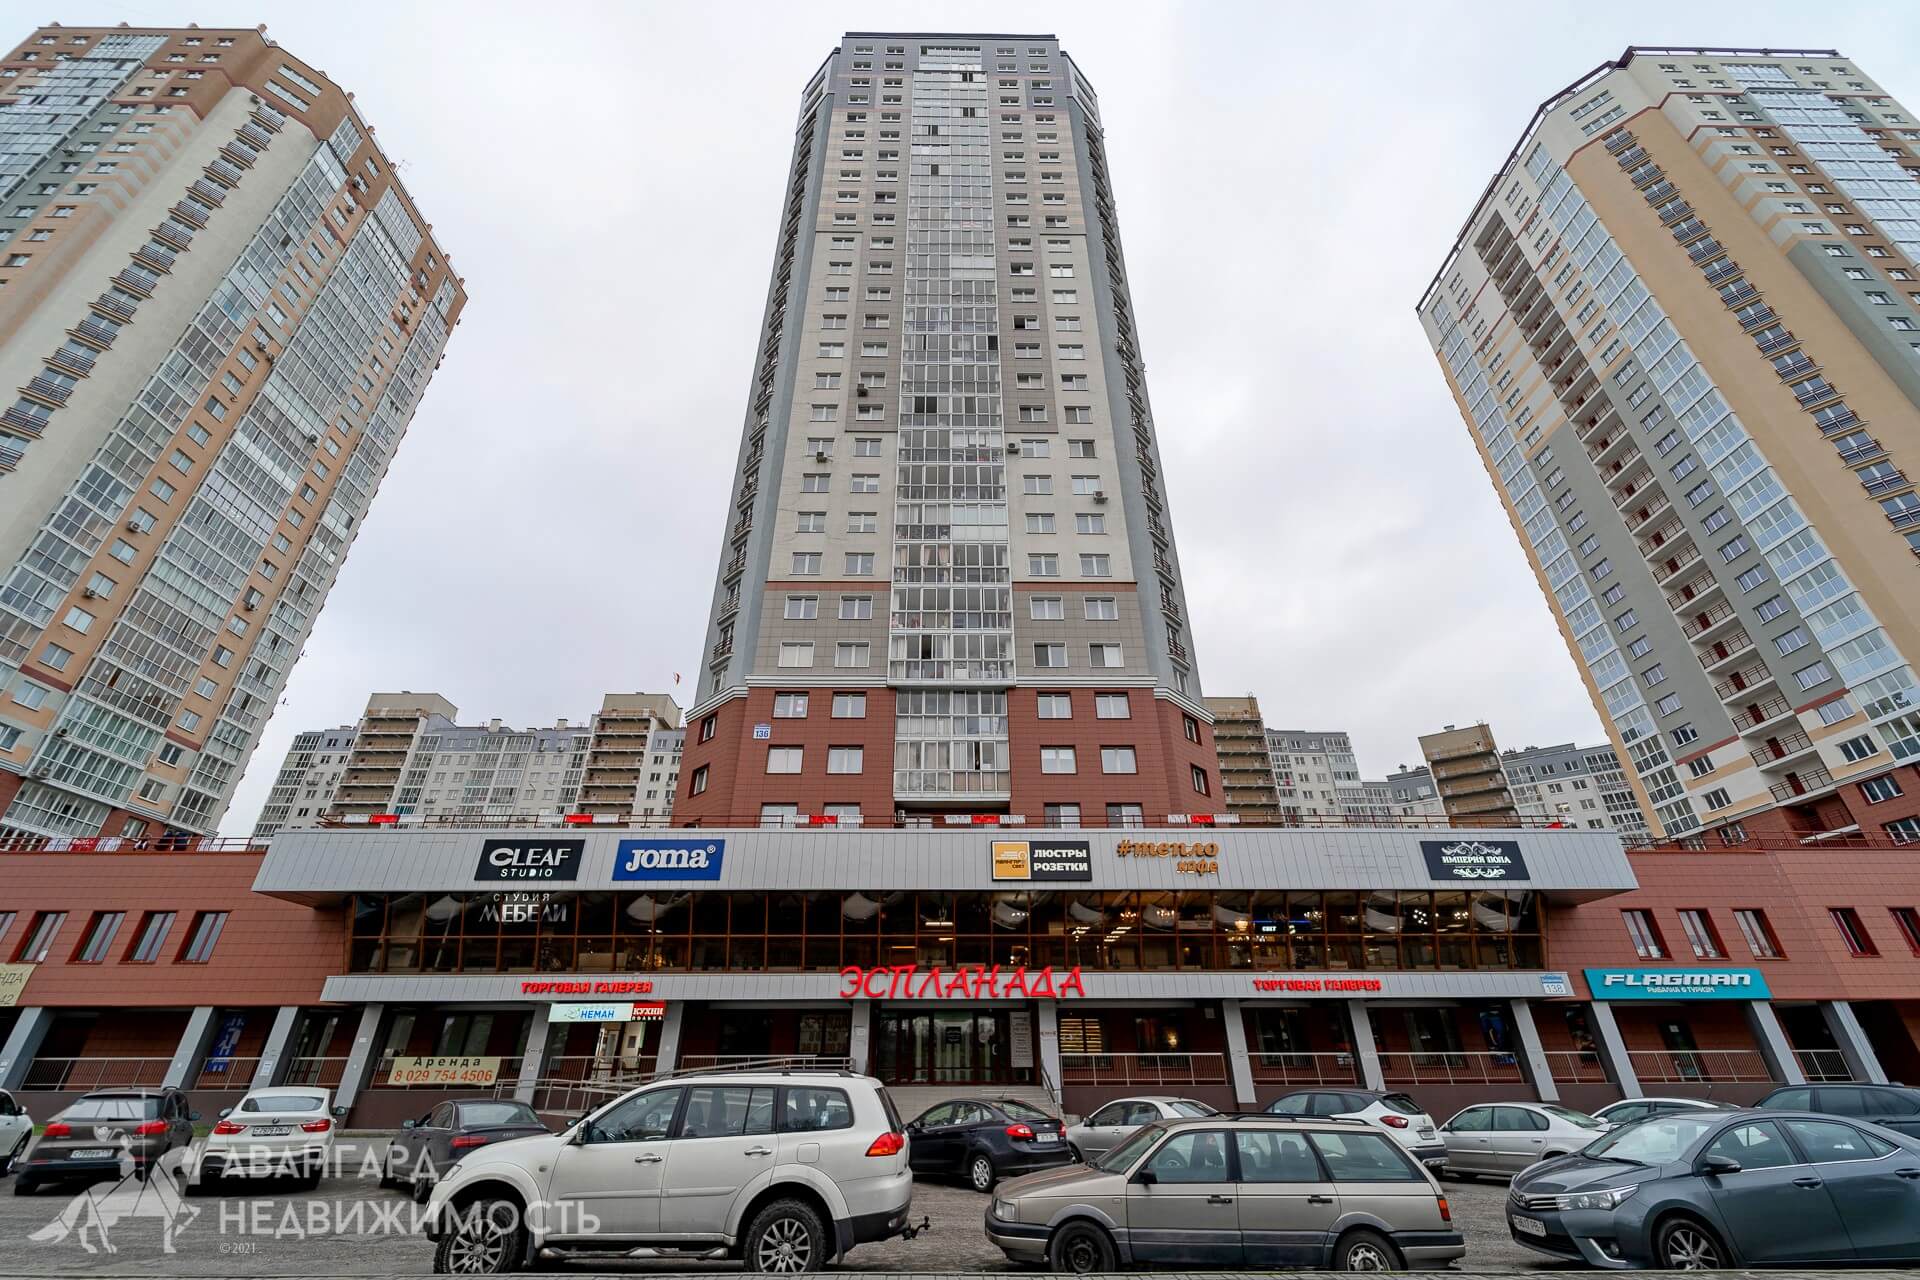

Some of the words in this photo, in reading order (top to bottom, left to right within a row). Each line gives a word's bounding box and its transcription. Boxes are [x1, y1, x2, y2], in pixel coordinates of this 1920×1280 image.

[1033, 849, 1087, 858] ЛЮСТРЫ
[1116, 840, 1219, 857] #тепло
[489, 848, 571, 866] CLEAF
[1442, 856, 1485, 864] ИМПЕРИЯ
[1486, 856, 1512, 864] ПОЛА
[1033, 863, 1088, 871] РОЗЕТКИ
[1176, 860, 1218, 876] кафе
[500, 869, 553, 877] STUDIO
[493, 893, 550, 901] СТУДИЯ
[479, 904, 567, 922] МЕБЕЛИ
[839, 965, 1086, 999] ЭСПЛАНАДА
[1253, 979, 1321, 991] ТОРГОВАЯ
[1325, 979, 1381, 991] ГАЛЕРЕЯ
[1604, 974, 1751, 986] FLAGMAN
[521, 982, 591, 993] ТОРГОВАЯ
[594, 982, 653, 993] ГАЛЕРЕЯ
[1546, 984, 1563, 993] 138
[633, 1007, 663, 1015] КУХНИ
[415, 1057, 481, 1068] Аренда
[395, 1071, 403, 1082] 8
[406, 1071, 429, 1082] 029
[434, 1071, 456, 1082] 754
[460, 1070, 492, 1082] 4506
